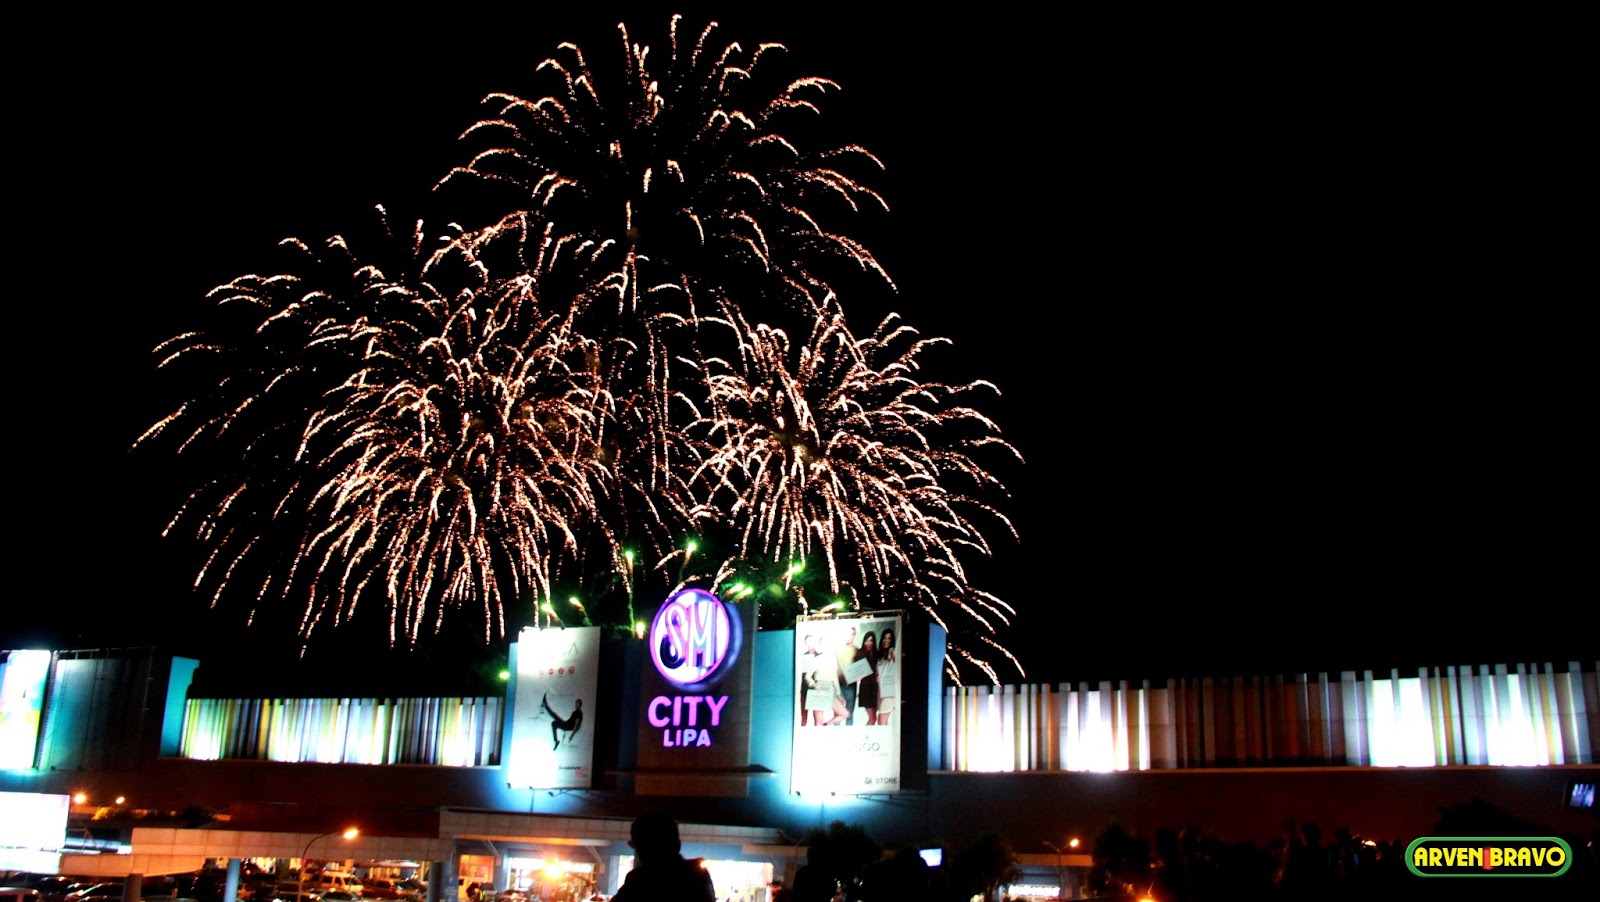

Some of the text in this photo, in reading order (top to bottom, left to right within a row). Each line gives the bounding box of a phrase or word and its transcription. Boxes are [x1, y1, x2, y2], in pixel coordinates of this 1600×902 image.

[659, 601, 718, 670] SM
[647, 695, 729, 728] CITY
[663, 729, 712, 747] LIPA
